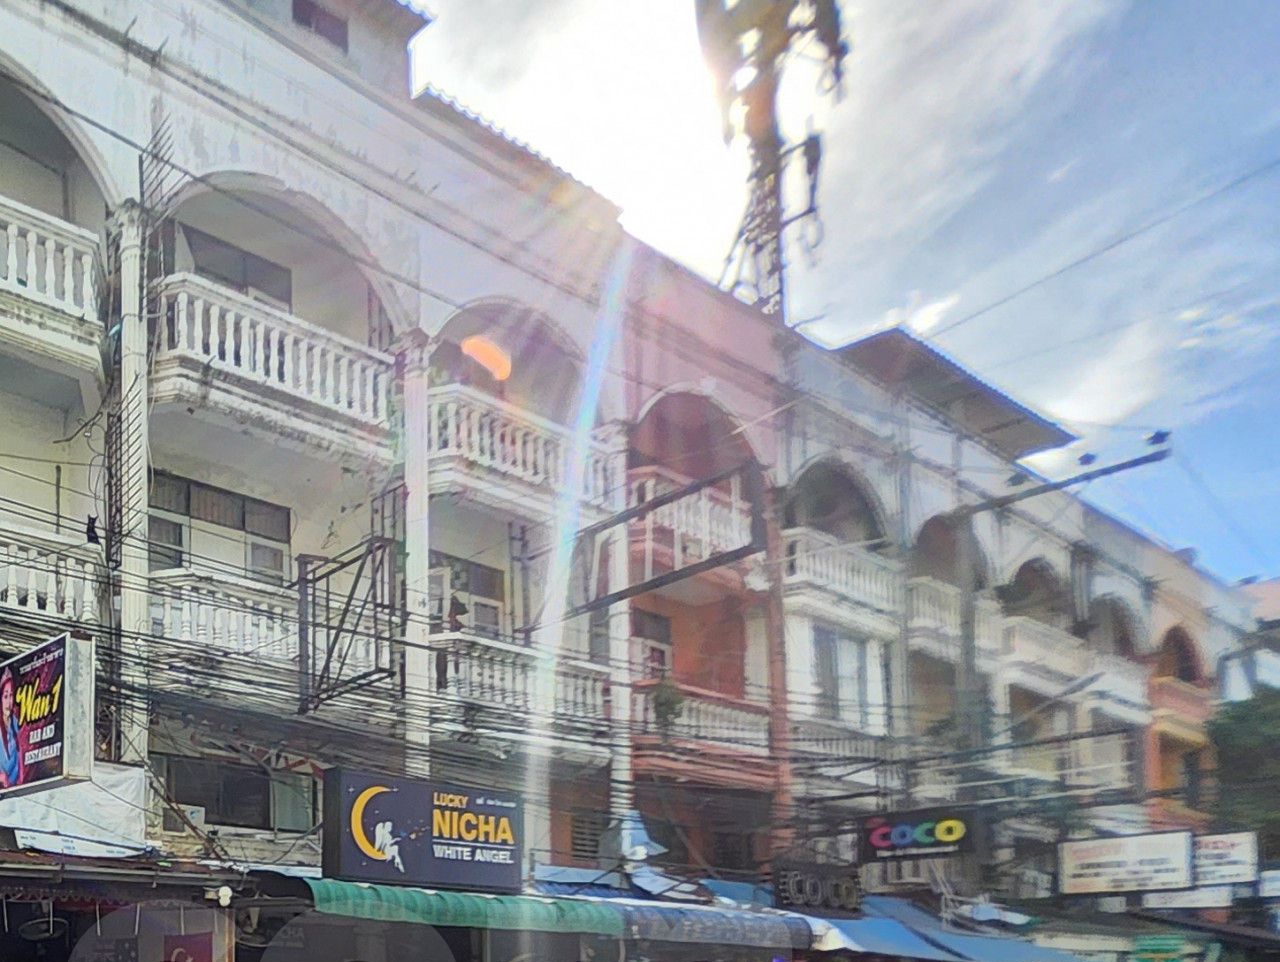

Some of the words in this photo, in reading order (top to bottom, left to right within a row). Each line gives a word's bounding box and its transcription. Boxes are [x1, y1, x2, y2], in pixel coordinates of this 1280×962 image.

[16, 677, 49, 725] Wan
[42, 724, 56, 739] AND
[433, 791, 469, 809] LUCKY
[432, 808, 515, 845] NICHA
[869, 819, 966, 848] COCO
[433, 844, 473, 861] WHITE
[473, 849, 515, 864] ANGEL
